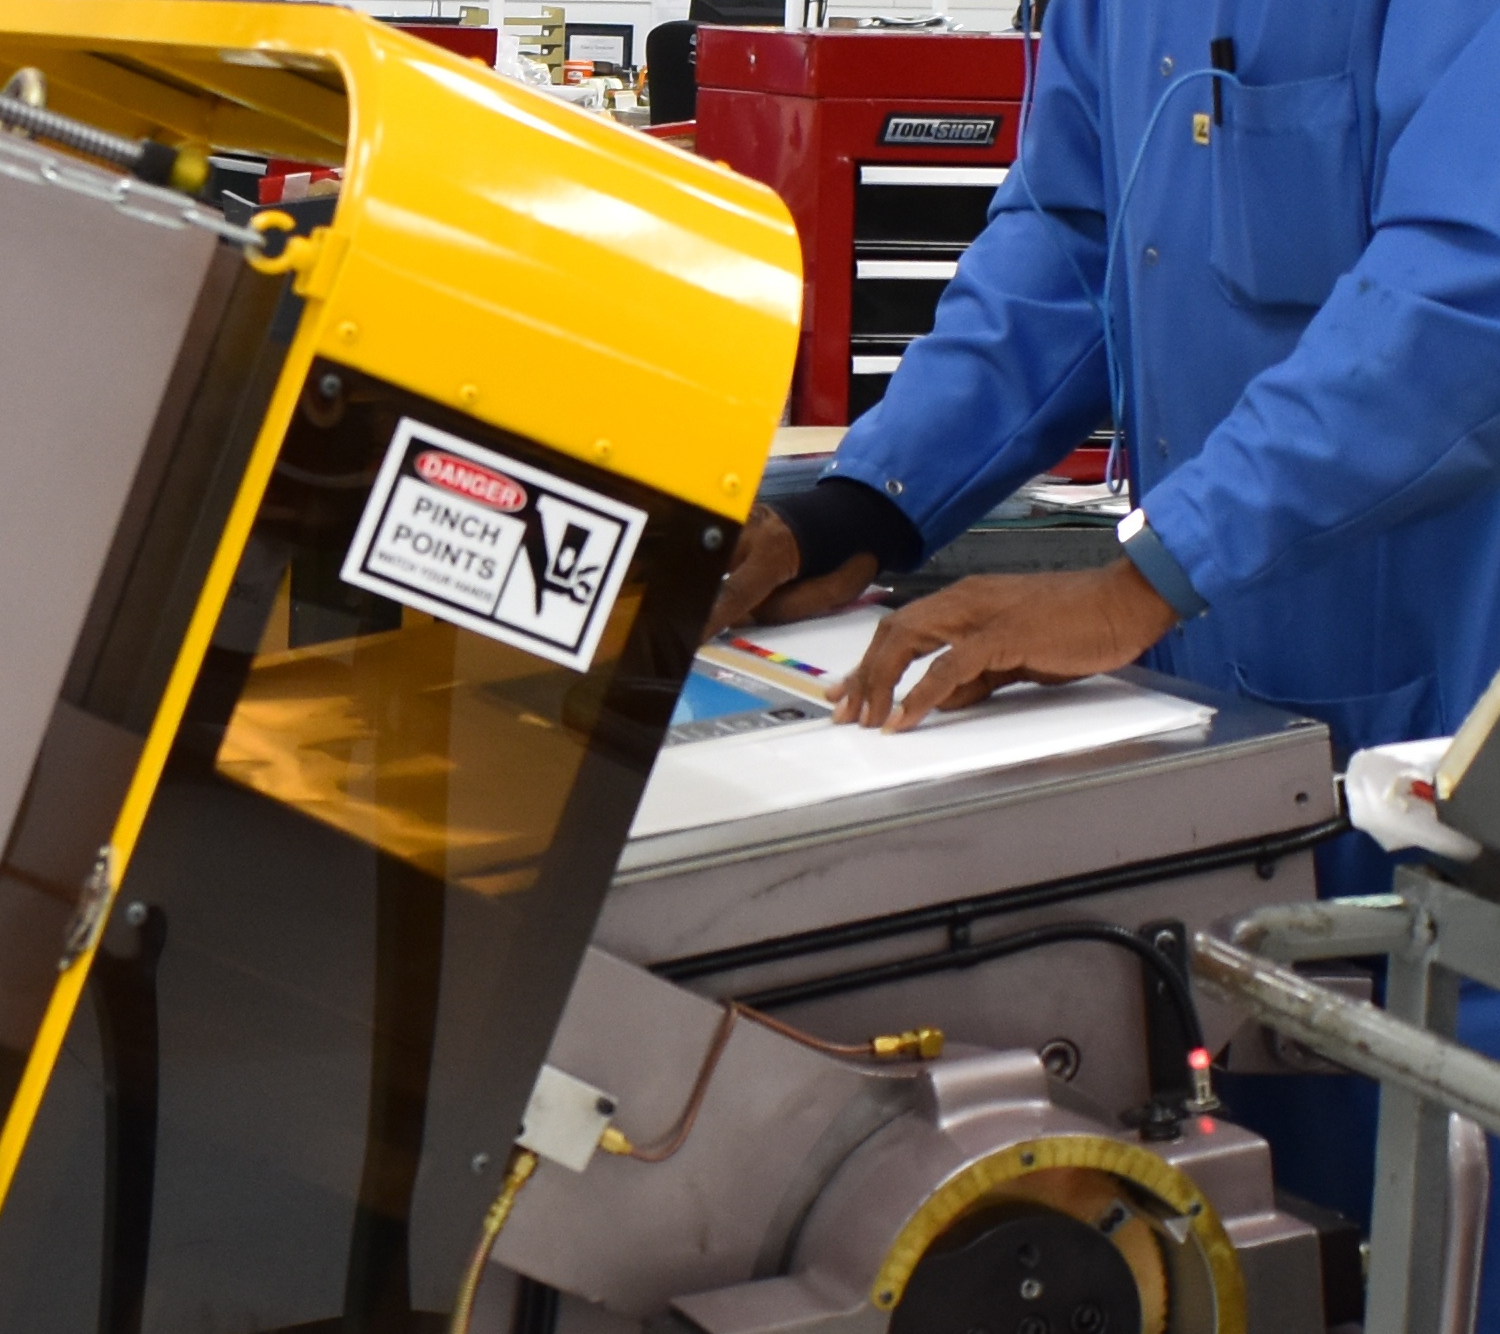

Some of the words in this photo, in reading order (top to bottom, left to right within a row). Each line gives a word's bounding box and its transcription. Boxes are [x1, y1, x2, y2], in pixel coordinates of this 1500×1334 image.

[892, 123, 934, 137] TOOL
[936, 124, 987, 139] SHOP
[422, 452, 518, 508] DANGER
[413, 496, 502, 547] PINCH
[392, 524, 498, 580] POINTS
